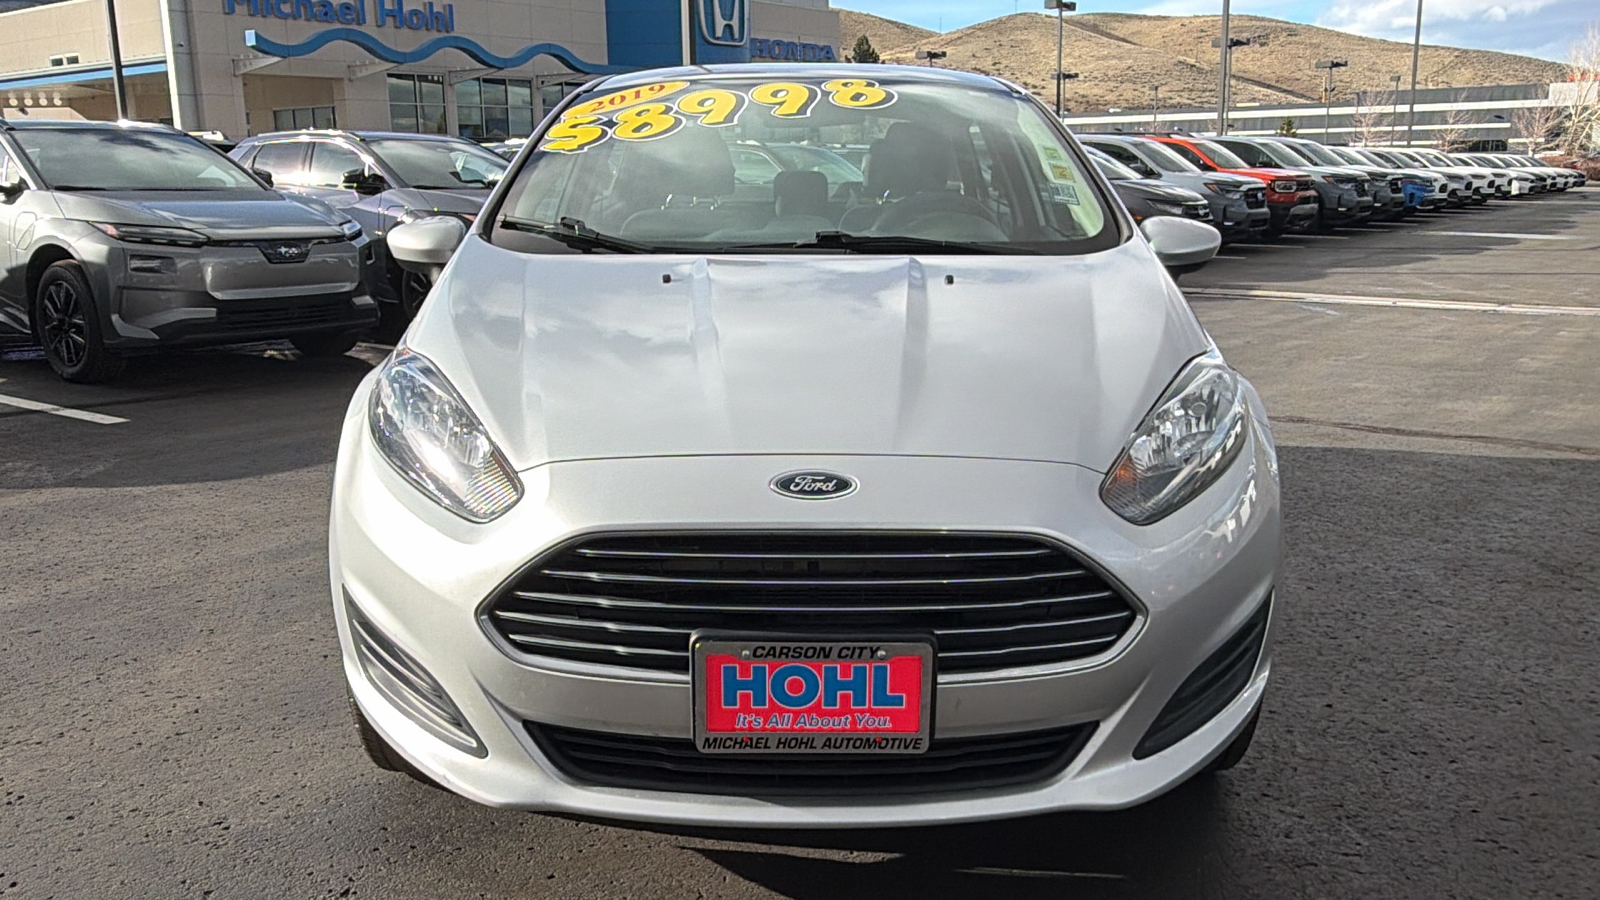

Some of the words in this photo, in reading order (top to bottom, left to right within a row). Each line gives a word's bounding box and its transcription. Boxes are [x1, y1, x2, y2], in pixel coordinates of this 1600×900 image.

[223, 0, 367, 25] Michael
[375, 0, 455, 32] Hohl
[750, 38, 837, 60] HONDA
[588, 84, 666, 112] 2019
[789, 475, 837, 491] Ford
[752, 646, 832, 659] CARSON
[837, 646, 880, 659] CITY
[721, 664, 905, 709] HOHL
[735, 713, 762, 728] It's
[767, 713, 791, 728] All
[795, 713, 851, 728] About
[856, 713, 892, 728] You.
[702, 737, 770, 750] MICHAEL
[778, 737, 817, 750] HOHL
[820, 737, 923, 750] AUTOMOTIVE
